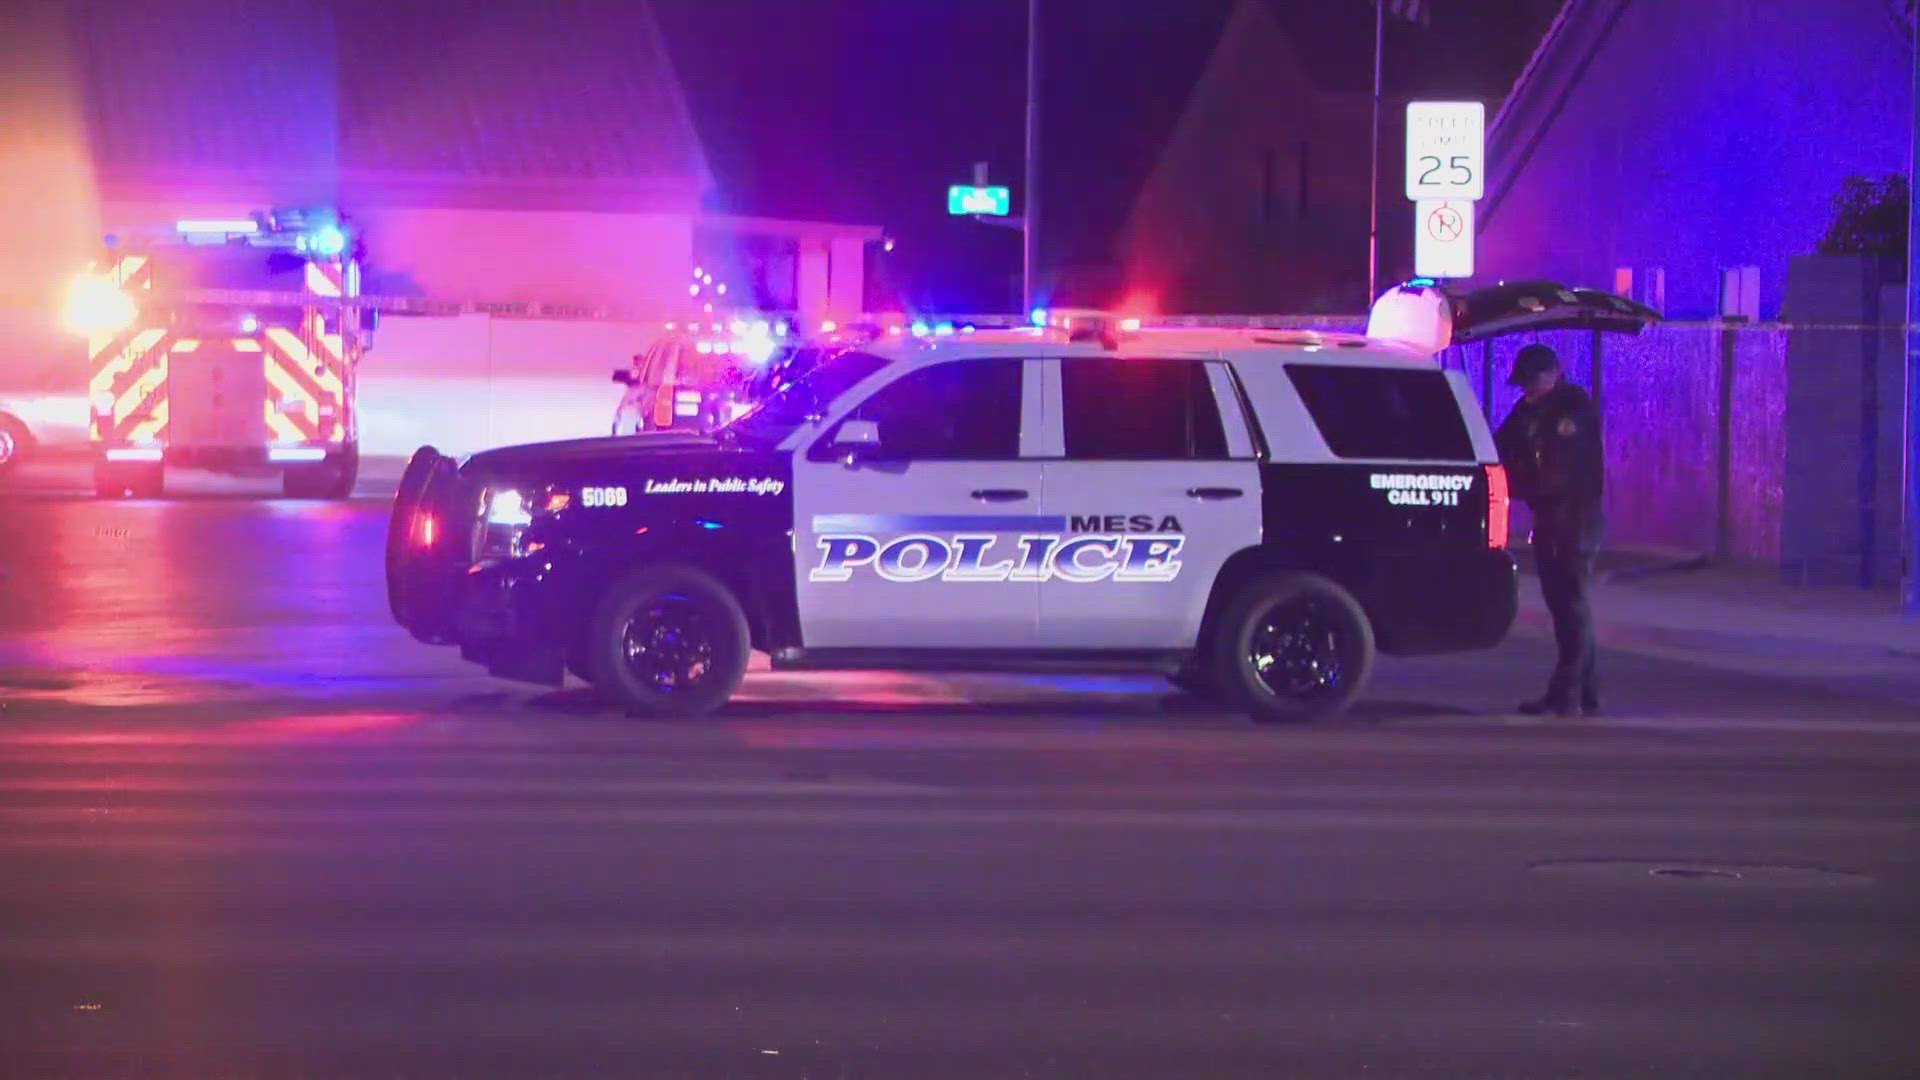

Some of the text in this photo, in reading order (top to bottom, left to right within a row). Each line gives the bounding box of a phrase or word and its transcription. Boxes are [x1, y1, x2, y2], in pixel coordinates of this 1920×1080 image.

[1419, 155, 1472, 185] 25
[644, 477, 692, 494] Leaders
[708, 477, 747, 493] Public
[747, 477, 784, 496] Safety
[1370, 474, 1474, 490] EMERGENCY
[1388, 490, 1458, 505] CALL 911
[1070, 515, 1183, 533] MESA
[809, 533, 1185, 582] POLICE
